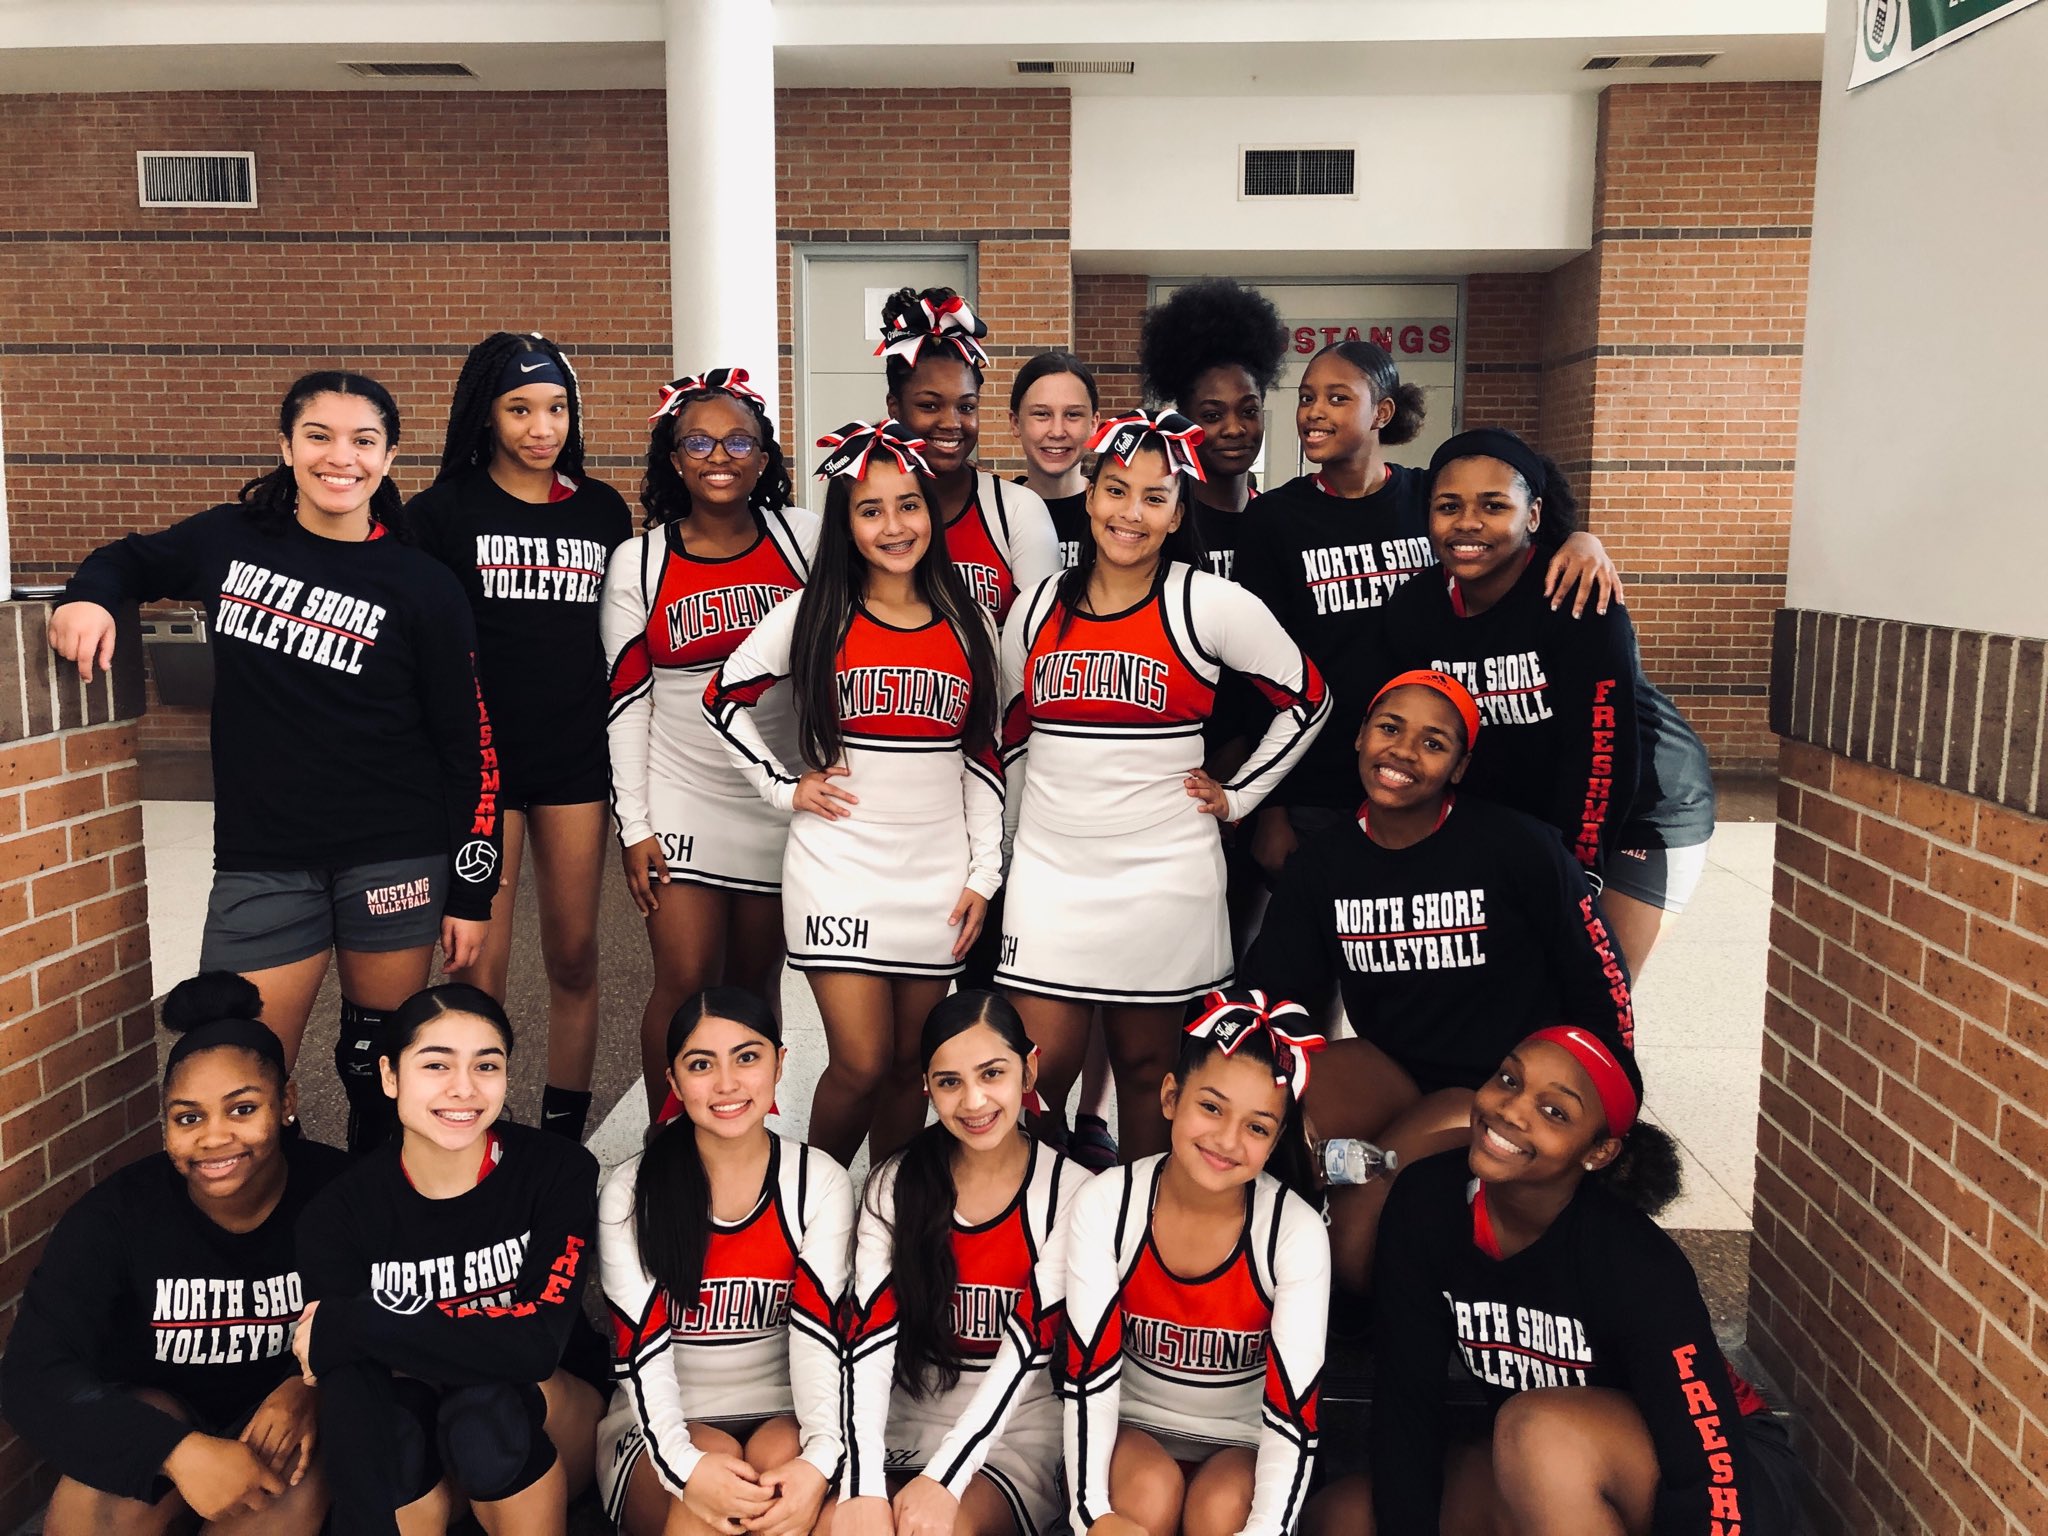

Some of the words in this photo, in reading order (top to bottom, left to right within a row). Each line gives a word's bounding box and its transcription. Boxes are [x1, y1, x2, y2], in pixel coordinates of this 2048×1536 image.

[1281, 325, 1453, 354] STANGS
[476, 534, 550, 566] NORTH
[1301, 543, 1378, 583] NORTH
[1381, 536, 1440, 571] SHOR
[221, 560, 305, 613] NORTH
[301, 586, 387, 640] SHORE
[481, 568, 602, 602] VOLLEYBAL
[1312, 572, 1420, 615] VOLLEY
[214, 599, 365, 675] VOLLEYBALL
[1032, 650, 1169, 713] MUSTANGS
[1484, 651, 1547, 692] SHORE
[836, 666, 970, 728] MUSTANGS
[1574, 679, 1617, 867] FRESHMAN
[365, 877, 430, 905] MUSTANG
[368, 892, 431, 915] VOLLEYBALL
[1334, 896, 1405, 934] NORTH
[1412, 889, 1486, 930] SHORE
[805, 914, 869, 949] NSSH
[1341, 932, 1486, 973] VOLLEYBALL
[371, 1255, 457, 1301] NORTH
[463, 1230, 531, 1294] SHOR
[152, 1278, 245, 1321] NORTH
[1442, 1291, 1511, 1343] RTH
[1516, 1306, 1593, 1363] SHORE
